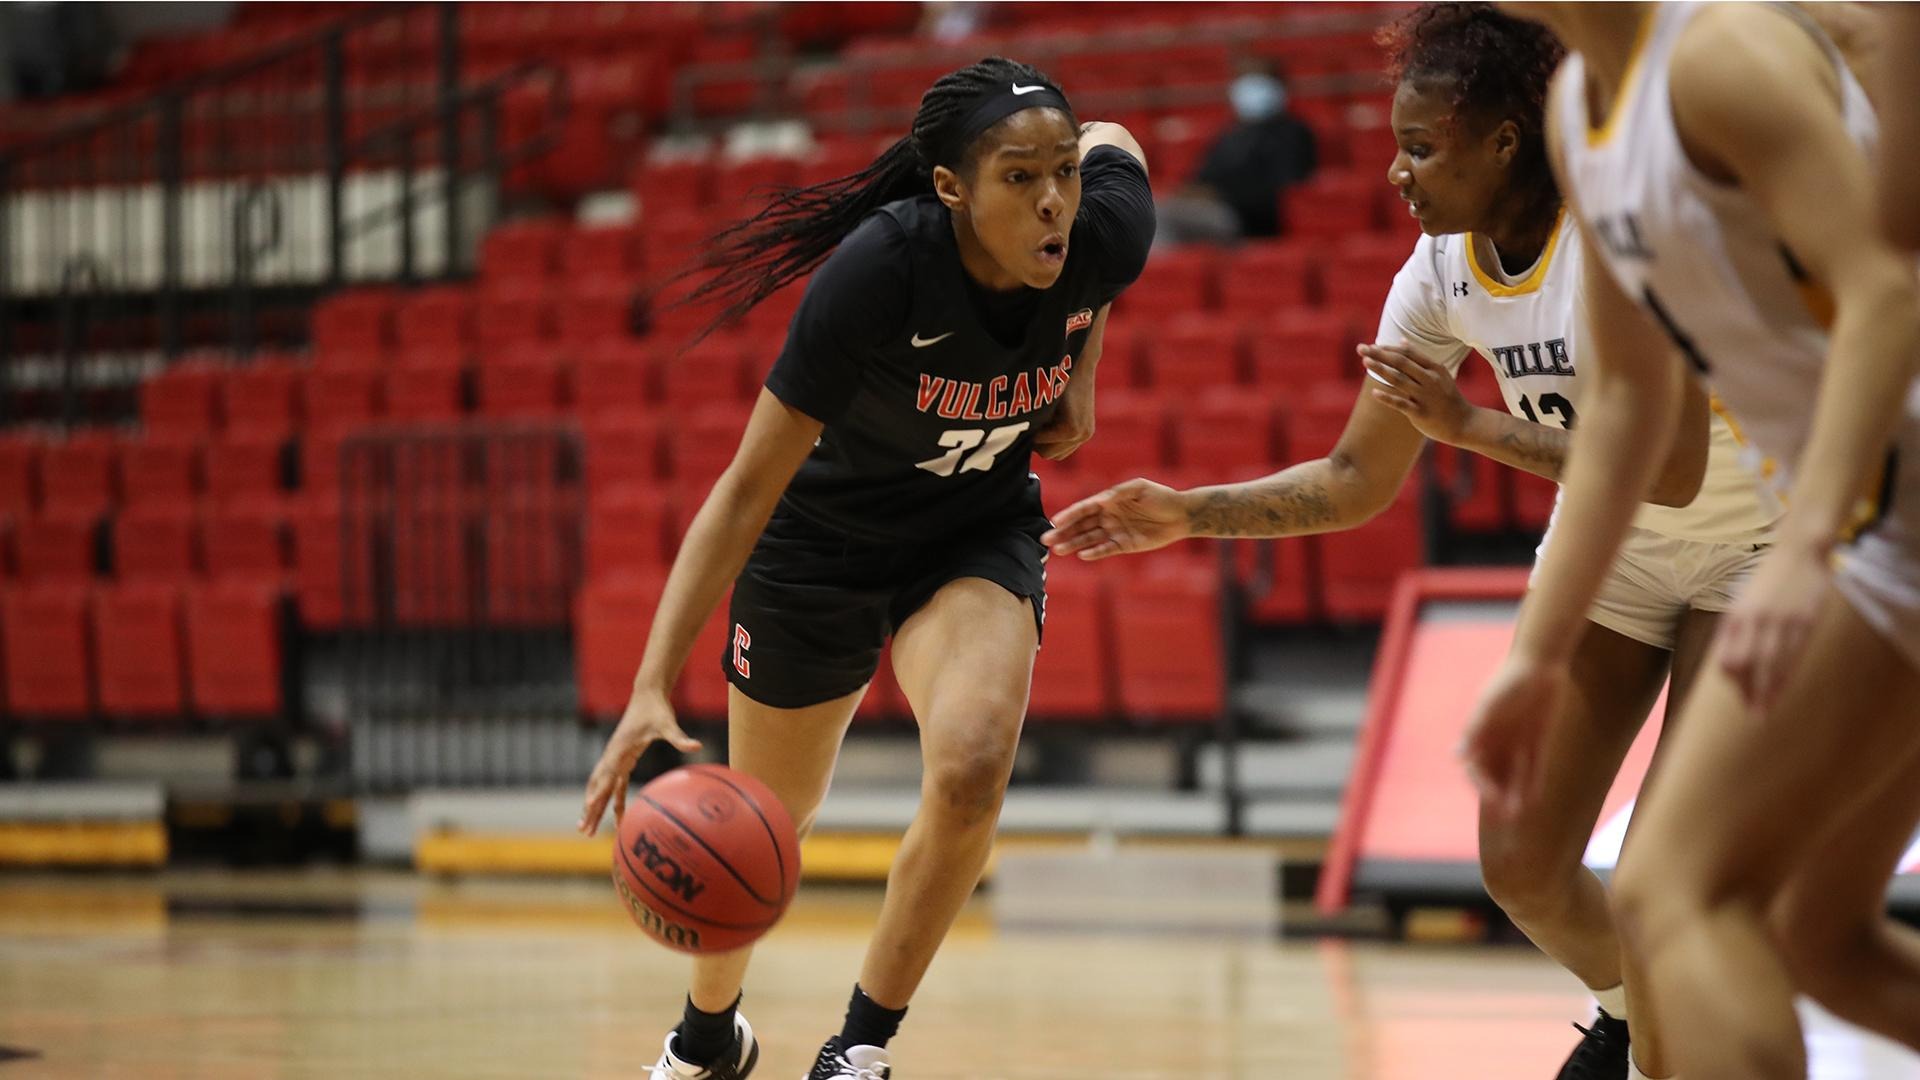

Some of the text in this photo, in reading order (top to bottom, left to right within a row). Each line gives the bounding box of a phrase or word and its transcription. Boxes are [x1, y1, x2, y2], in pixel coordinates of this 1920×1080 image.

[916, 354, 1072, 420] VULCANS
[733, 623, 751, 679] C
[633, 833, 704, 902] NCAA
